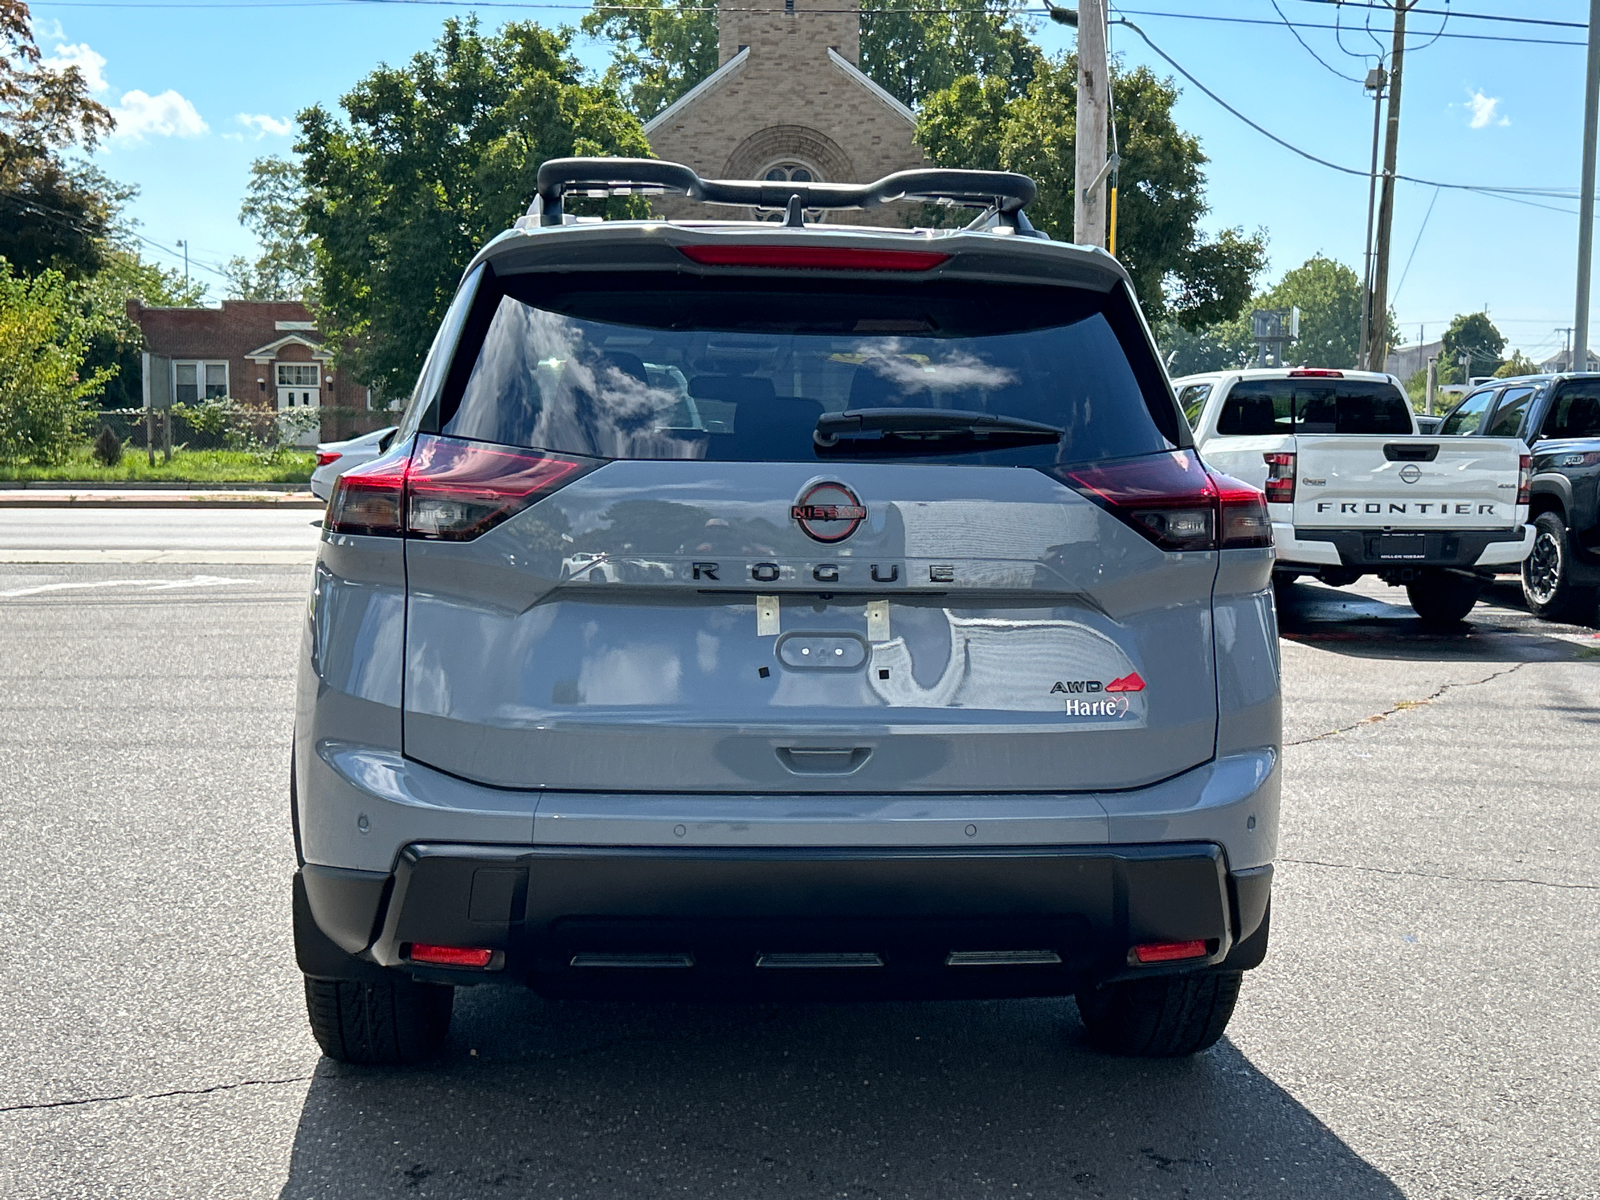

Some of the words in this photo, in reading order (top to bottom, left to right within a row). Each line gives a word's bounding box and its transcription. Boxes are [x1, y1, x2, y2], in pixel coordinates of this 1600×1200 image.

[793, 507, 865, 518] NISSAN
[1317, 502, 1496, 515] FRONTIER
[692, 562, 955, 583] ROGUE
[1050, 680, 1103, 694] AWD
[1066, 699, 1117, 716] Harte
